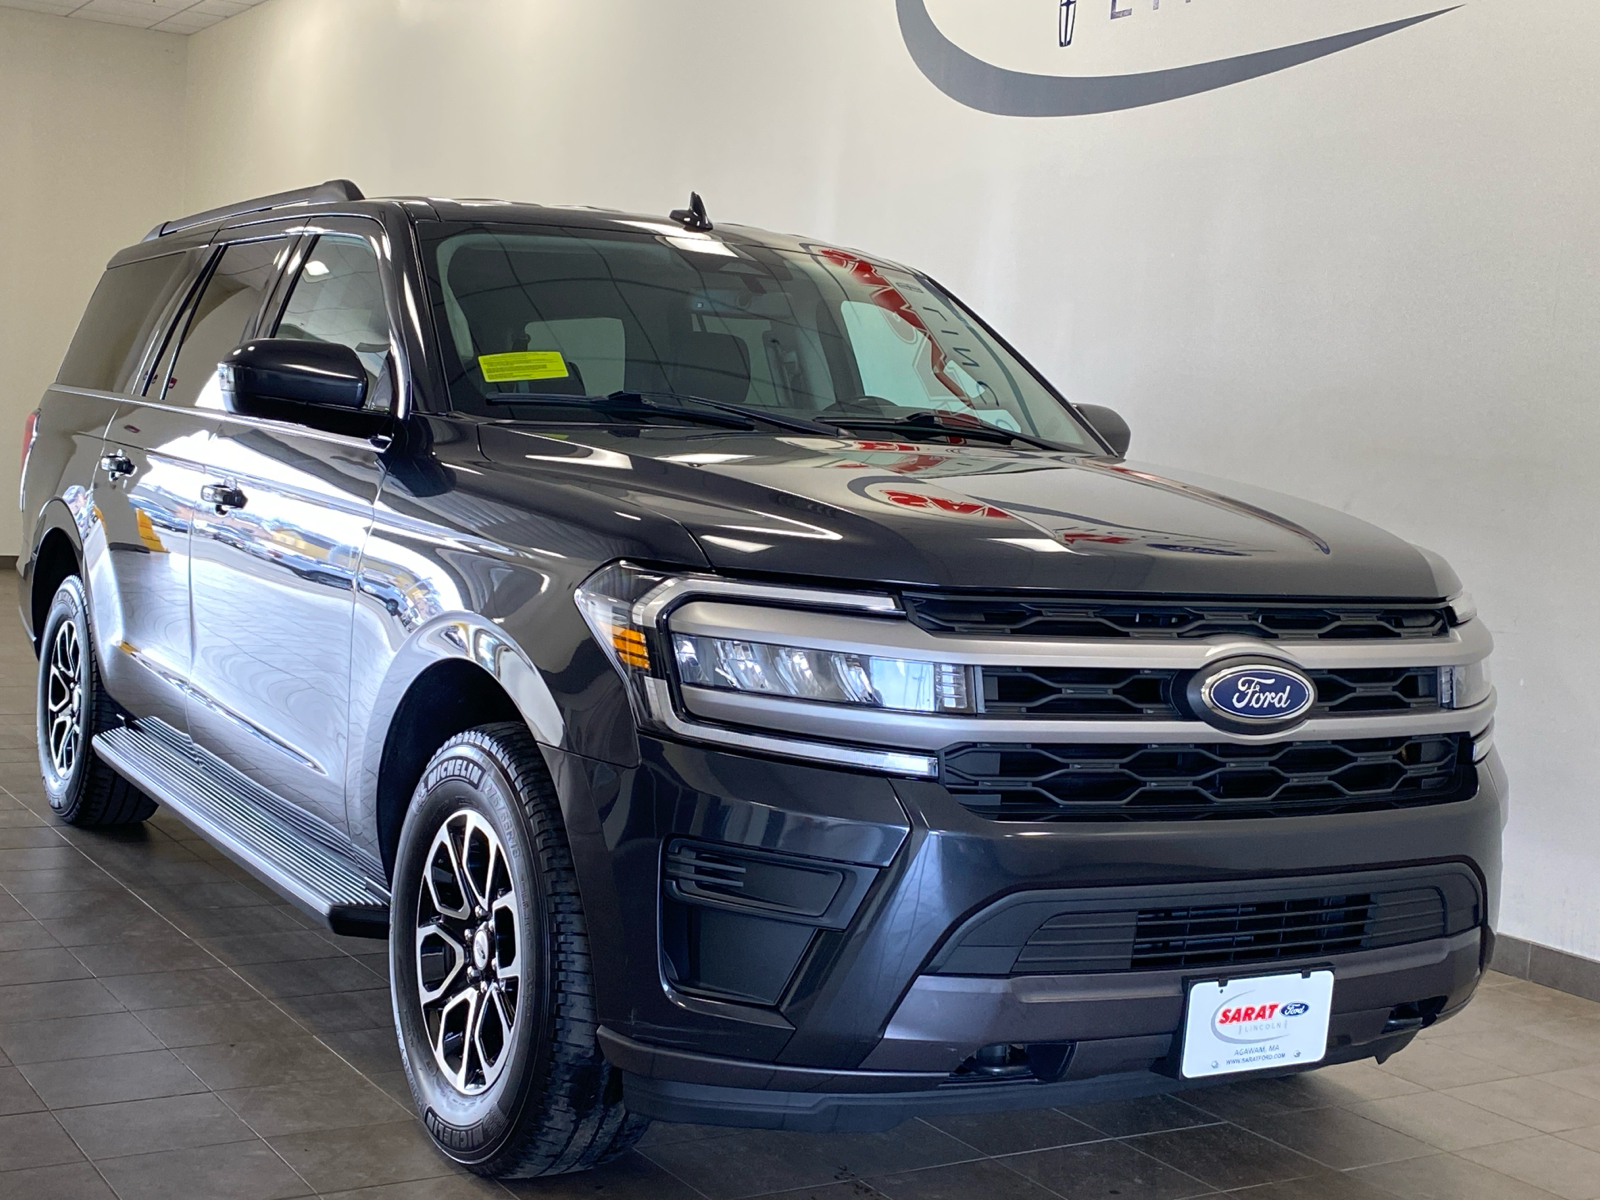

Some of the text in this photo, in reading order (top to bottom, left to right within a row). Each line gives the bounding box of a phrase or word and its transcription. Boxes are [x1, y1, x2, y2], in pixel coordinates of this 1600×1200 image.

[1232, 676, 1291, 708] Ford
[427, 759, 482, 790] MICHELIN
[1218, 1003, 1305, 1025] SARAT Ford
[1244, 1022, 1282, 1033] LINCOLN
[1269, 1044, 1280, 1052] MA
[426, 1111, 484, 1148] MICHELIN
